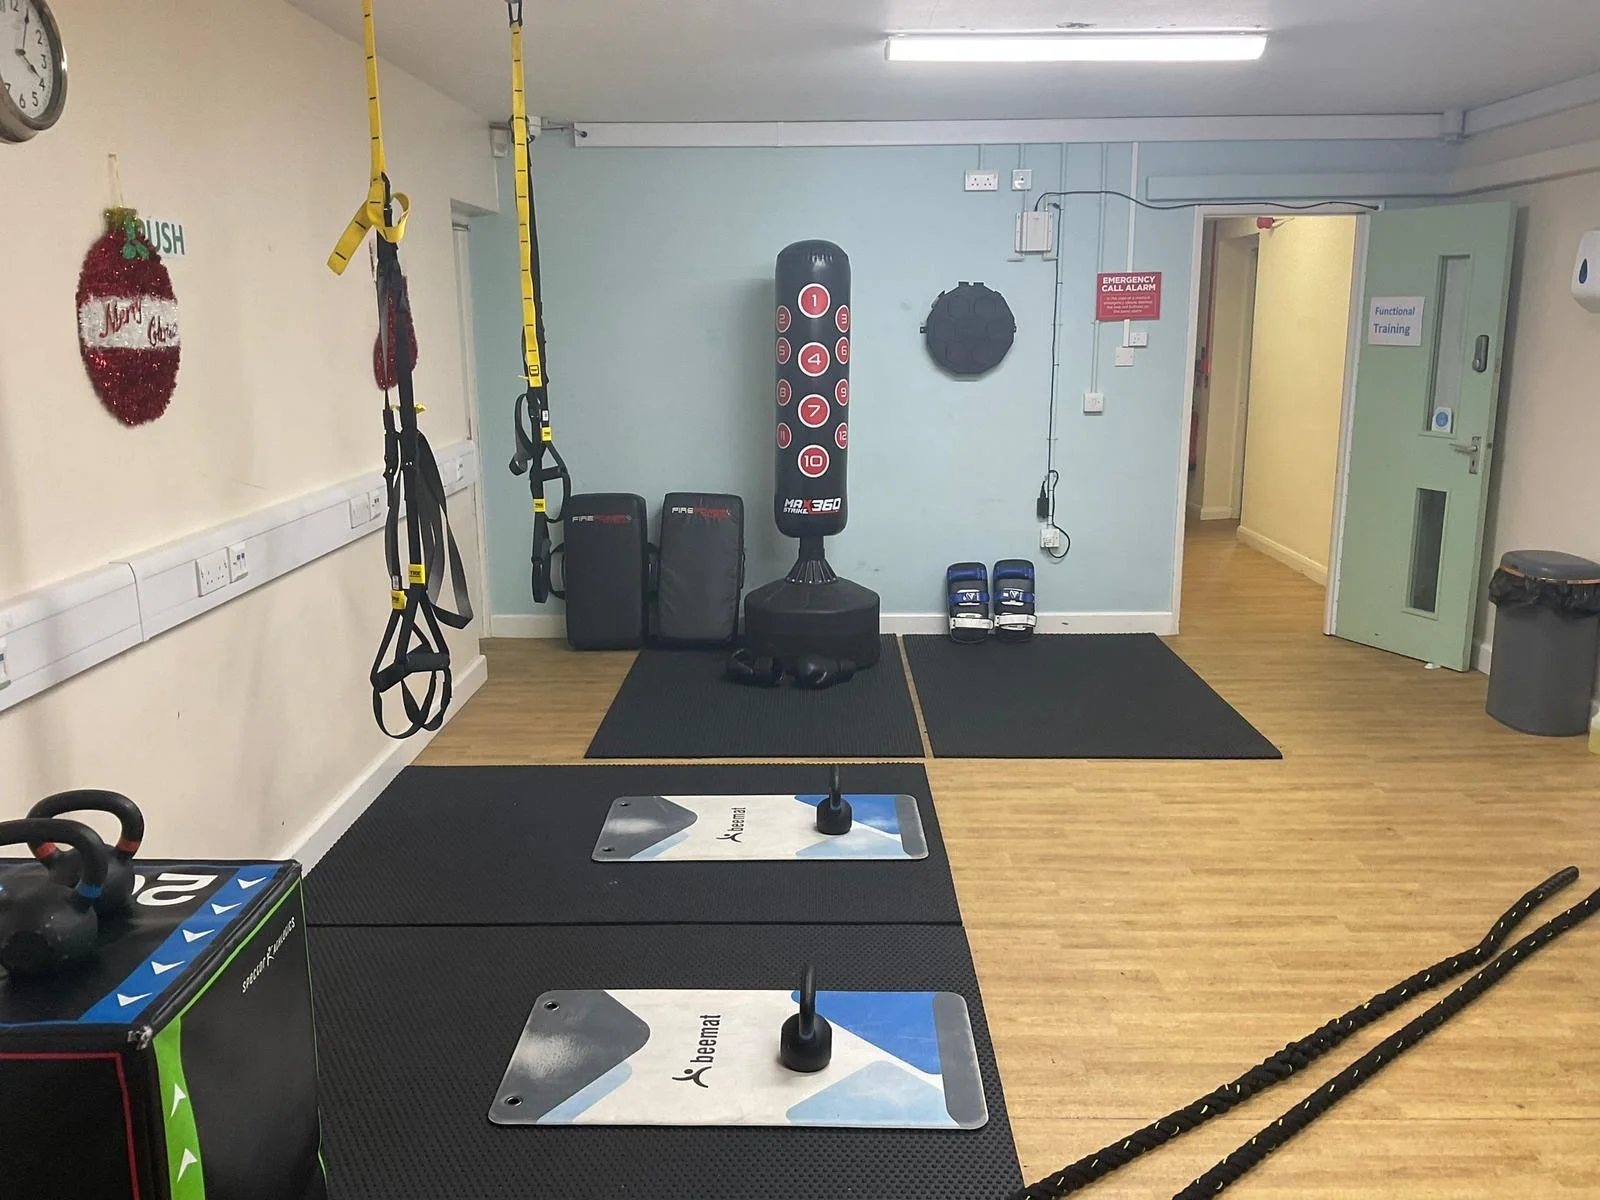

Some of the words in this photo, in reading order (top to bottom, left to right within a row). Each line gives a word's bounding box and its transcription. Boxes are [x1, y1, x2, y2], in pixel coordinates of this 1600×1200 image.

[36, 29, 42, 45] 2
[40, 54, 47, 69] 3
[39, 78, 45, 91] 4
[19, 94, 26, 108] 6
[32, 92, 39, 107] 5
[1102, 276, 1156, 284] EMERGENCY
[1101, 284, 1124, 292] CALL
[1125, 283, 1156, 292] ALARM
[811, 294, 818, 307] 1
[1375, 306, 1416, 316] Functional
[779, 313, 786, 325] 2
[841, 313, 848, 325] 3
[1373, 323, 1411, 337] Training
[779, 345, 786, 356] 5
[841, 345, 848, 356] 6
[807, 353, 822, 366] 4
[840, 387, 847, 398] 9
[807, 404, 821, 417] 7
[839, 430, 847, 441] 12
[804, 455, 823, 468] 10
[811, 497, 842, 512] 360
[727, 807, 746, 831] beemat
[689, 1014, 721, 1063] beemat
